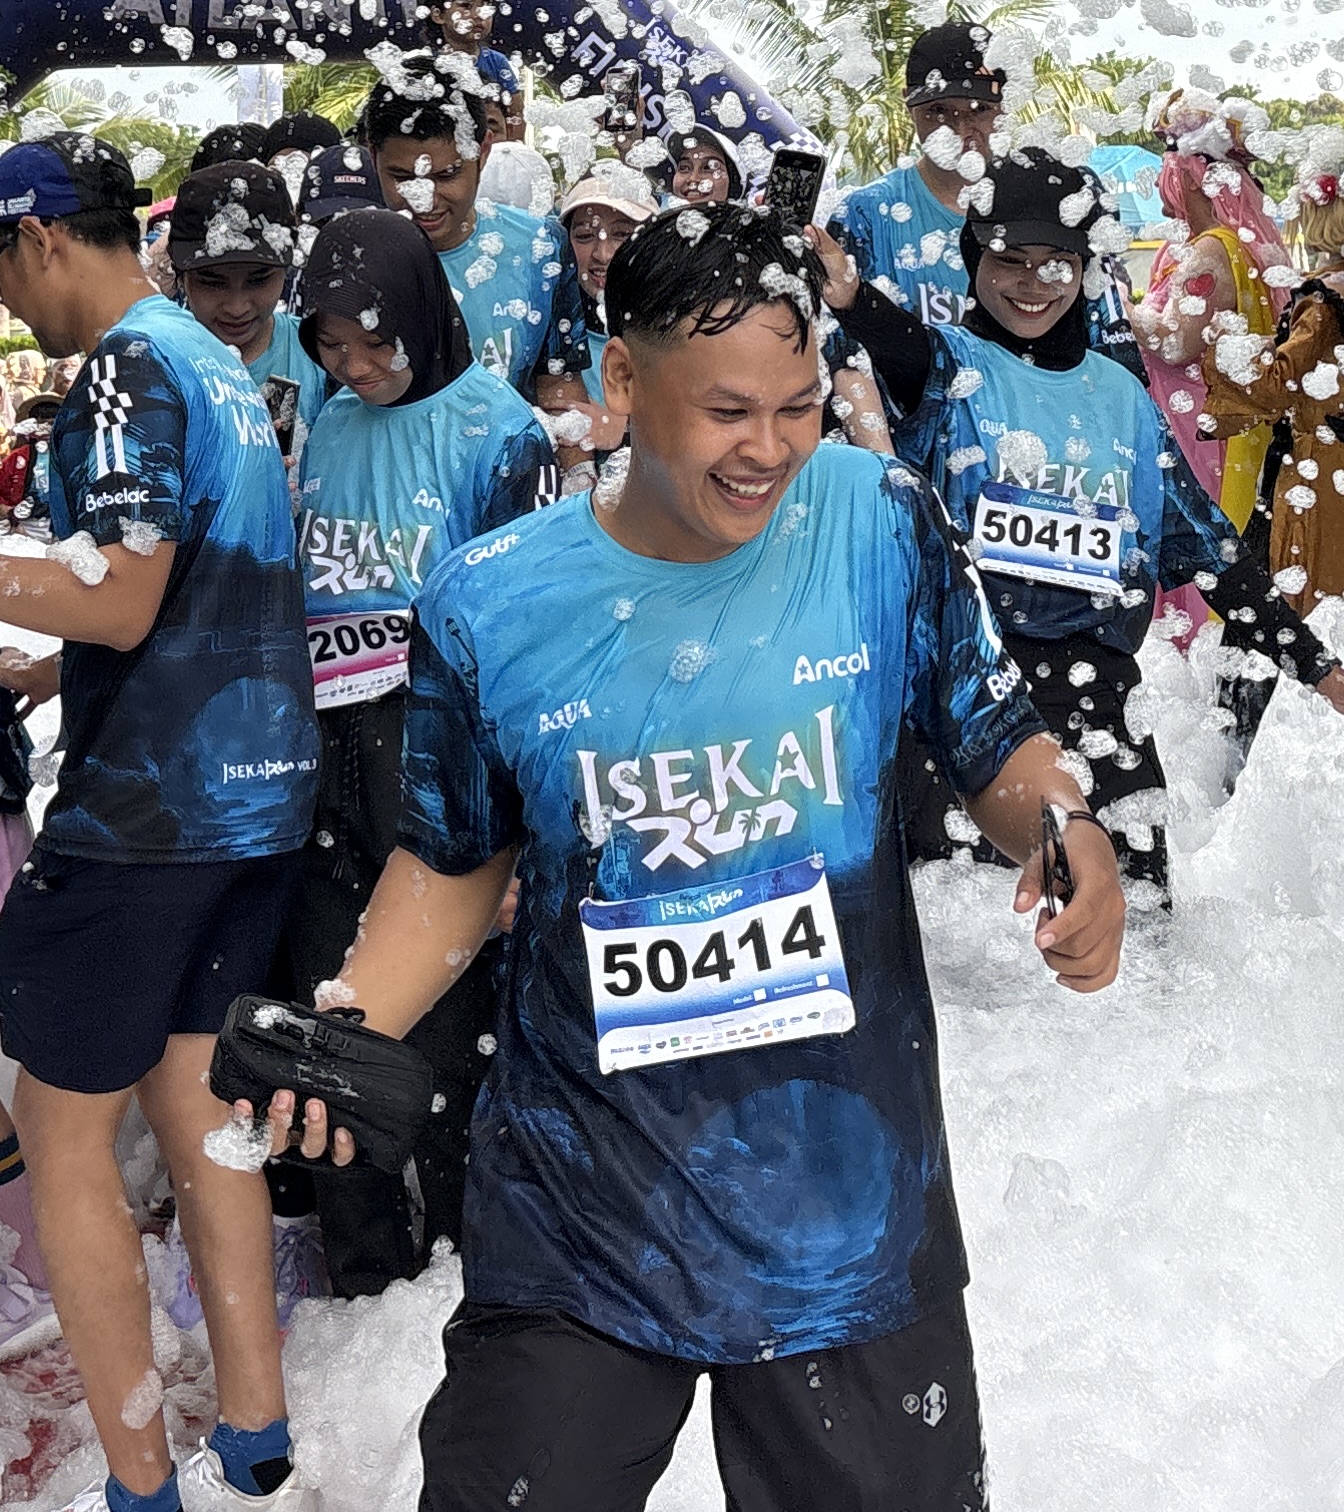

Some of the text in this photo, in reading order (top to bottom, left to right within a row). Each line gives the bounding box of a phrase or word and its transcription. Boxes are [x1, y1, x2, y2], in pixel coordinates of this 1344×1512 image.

[85, 487, 150, 512] Bebelac
[981, 508, 1113, 561] 50413
[308, 552, 395, 596] Run
[792, 643, 870, 685] Ancol
[538, 698, 593, 735] AQUA
[576, 704, 844, 823] ISEKAI
[626, 798, 799, 872] Run
[602, 904, 826, 998] 50414
